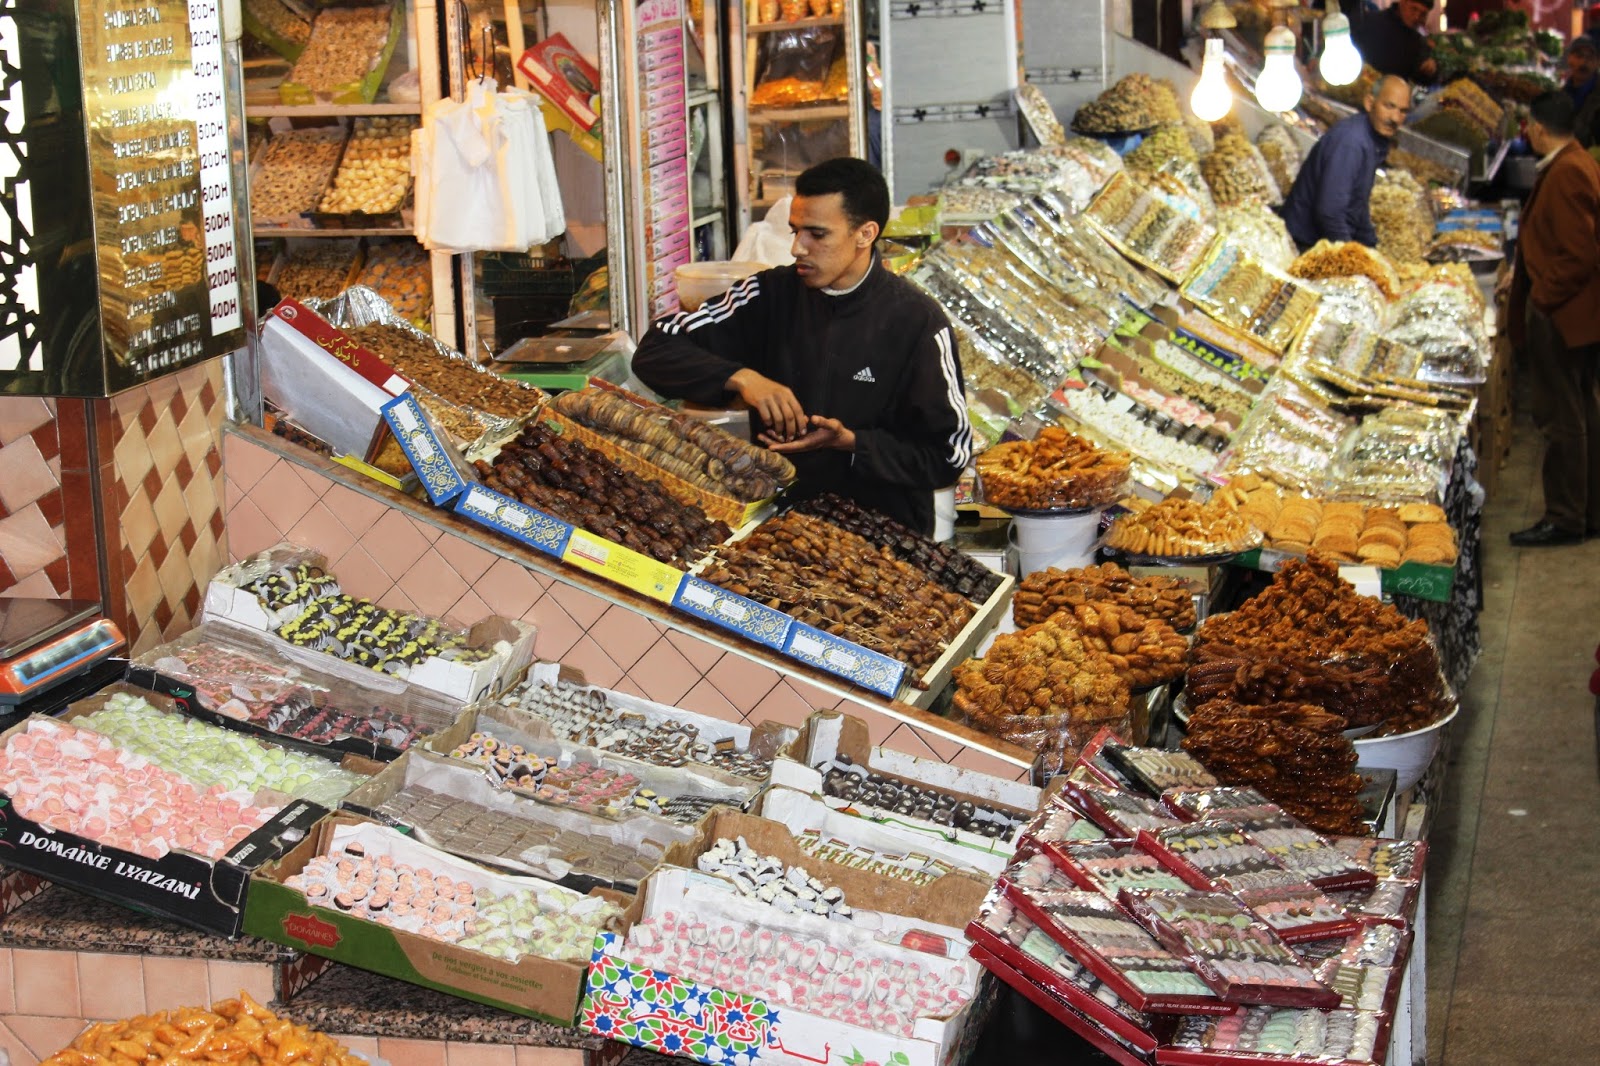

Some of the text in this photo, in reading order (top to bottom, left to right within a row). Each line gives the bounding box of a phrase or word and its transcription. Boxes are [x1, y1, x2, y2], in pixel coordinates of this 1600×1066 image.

[190, 3, 216, 20] 80DH
[106, 37, 173, 62] CORNES DE GAZELLE
[194, 61, 220, 78] 40DH
[196, 91, 222, 109] 25DH
[198, 121, 224, 140] 50DH
[143, 137, 157, 153] AUX
[115, 171, 145, 192] GATEAUX
[147, 167, 160, 185] AUX
[202, 182, 229, 202] 60DH
[118, 202, 147, 224] GATEAUX
[164, 189, 198, 212] CHOCOLAT
[204, 212, 230, 233] 50DH
[206, 241, 233, 263] 50DH
[210, 298, 238, 319] 40DH
[19, 831, 202, 900] DOMAINE LYAZAMI
[290, 922, 333, 942] DOMAINES
[444, 955, 457, 965] nos
[460, 960, 487, 973] vergers
[495, 970, 508, 980] vos
[510, 975, 544, 990] assiettes
[601, 990, 831, 1065] لذات المغرب
